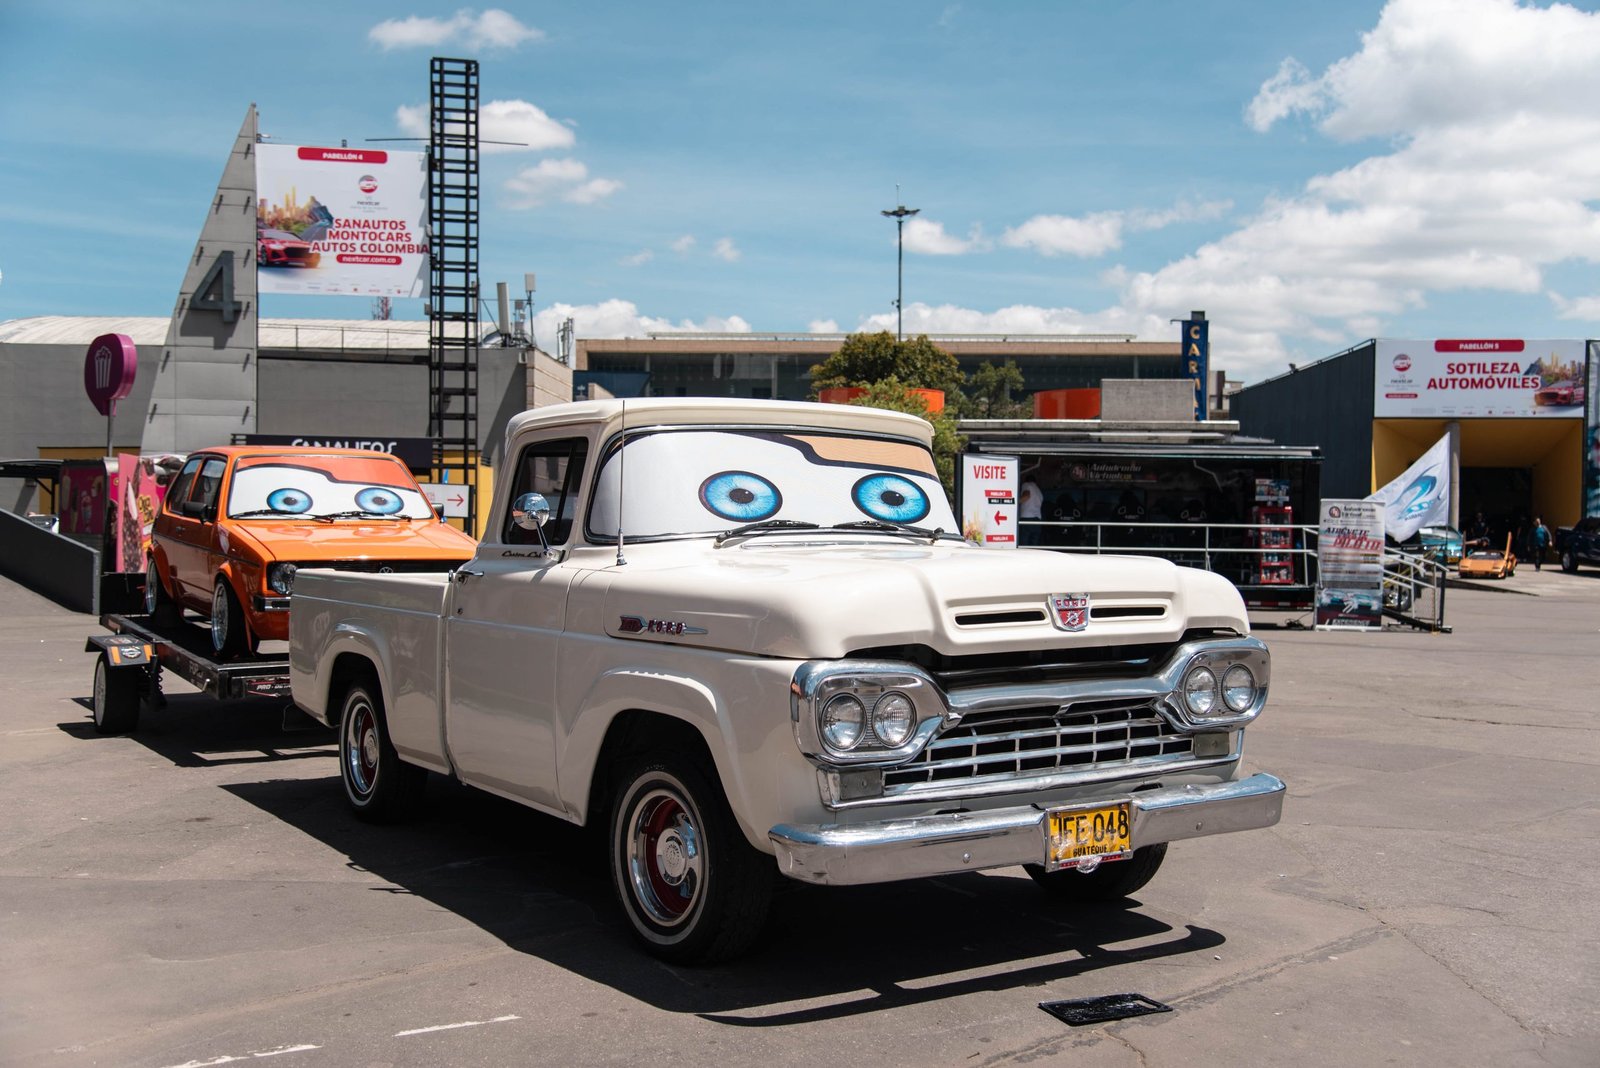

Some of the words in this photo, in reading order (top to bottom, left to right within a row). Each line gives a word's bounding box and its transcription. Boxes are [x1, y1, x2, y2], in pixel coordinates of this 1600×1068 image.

[334, 218, 406, 231] SANAUTOS
[328, 230, 412, 242] MONTOCARS
[311, 242, 356, 253] AUTOS
[360, 243, 430, 254] COLOMBIA
[342, 256, 396, 264] nextcar.com.co
[189, 250, 243, 322] 4
[1446, 362, 1520, 375] SOTILEZA
[1426, 375, 1541, 390] AUTOMÓVILES
[973, 465, 1006, 480] VISITE
[1056, 598, 1087, 607] FORD
[647, 619, 687, 636] FORD
[1093, 810, 1129, 844] 048
